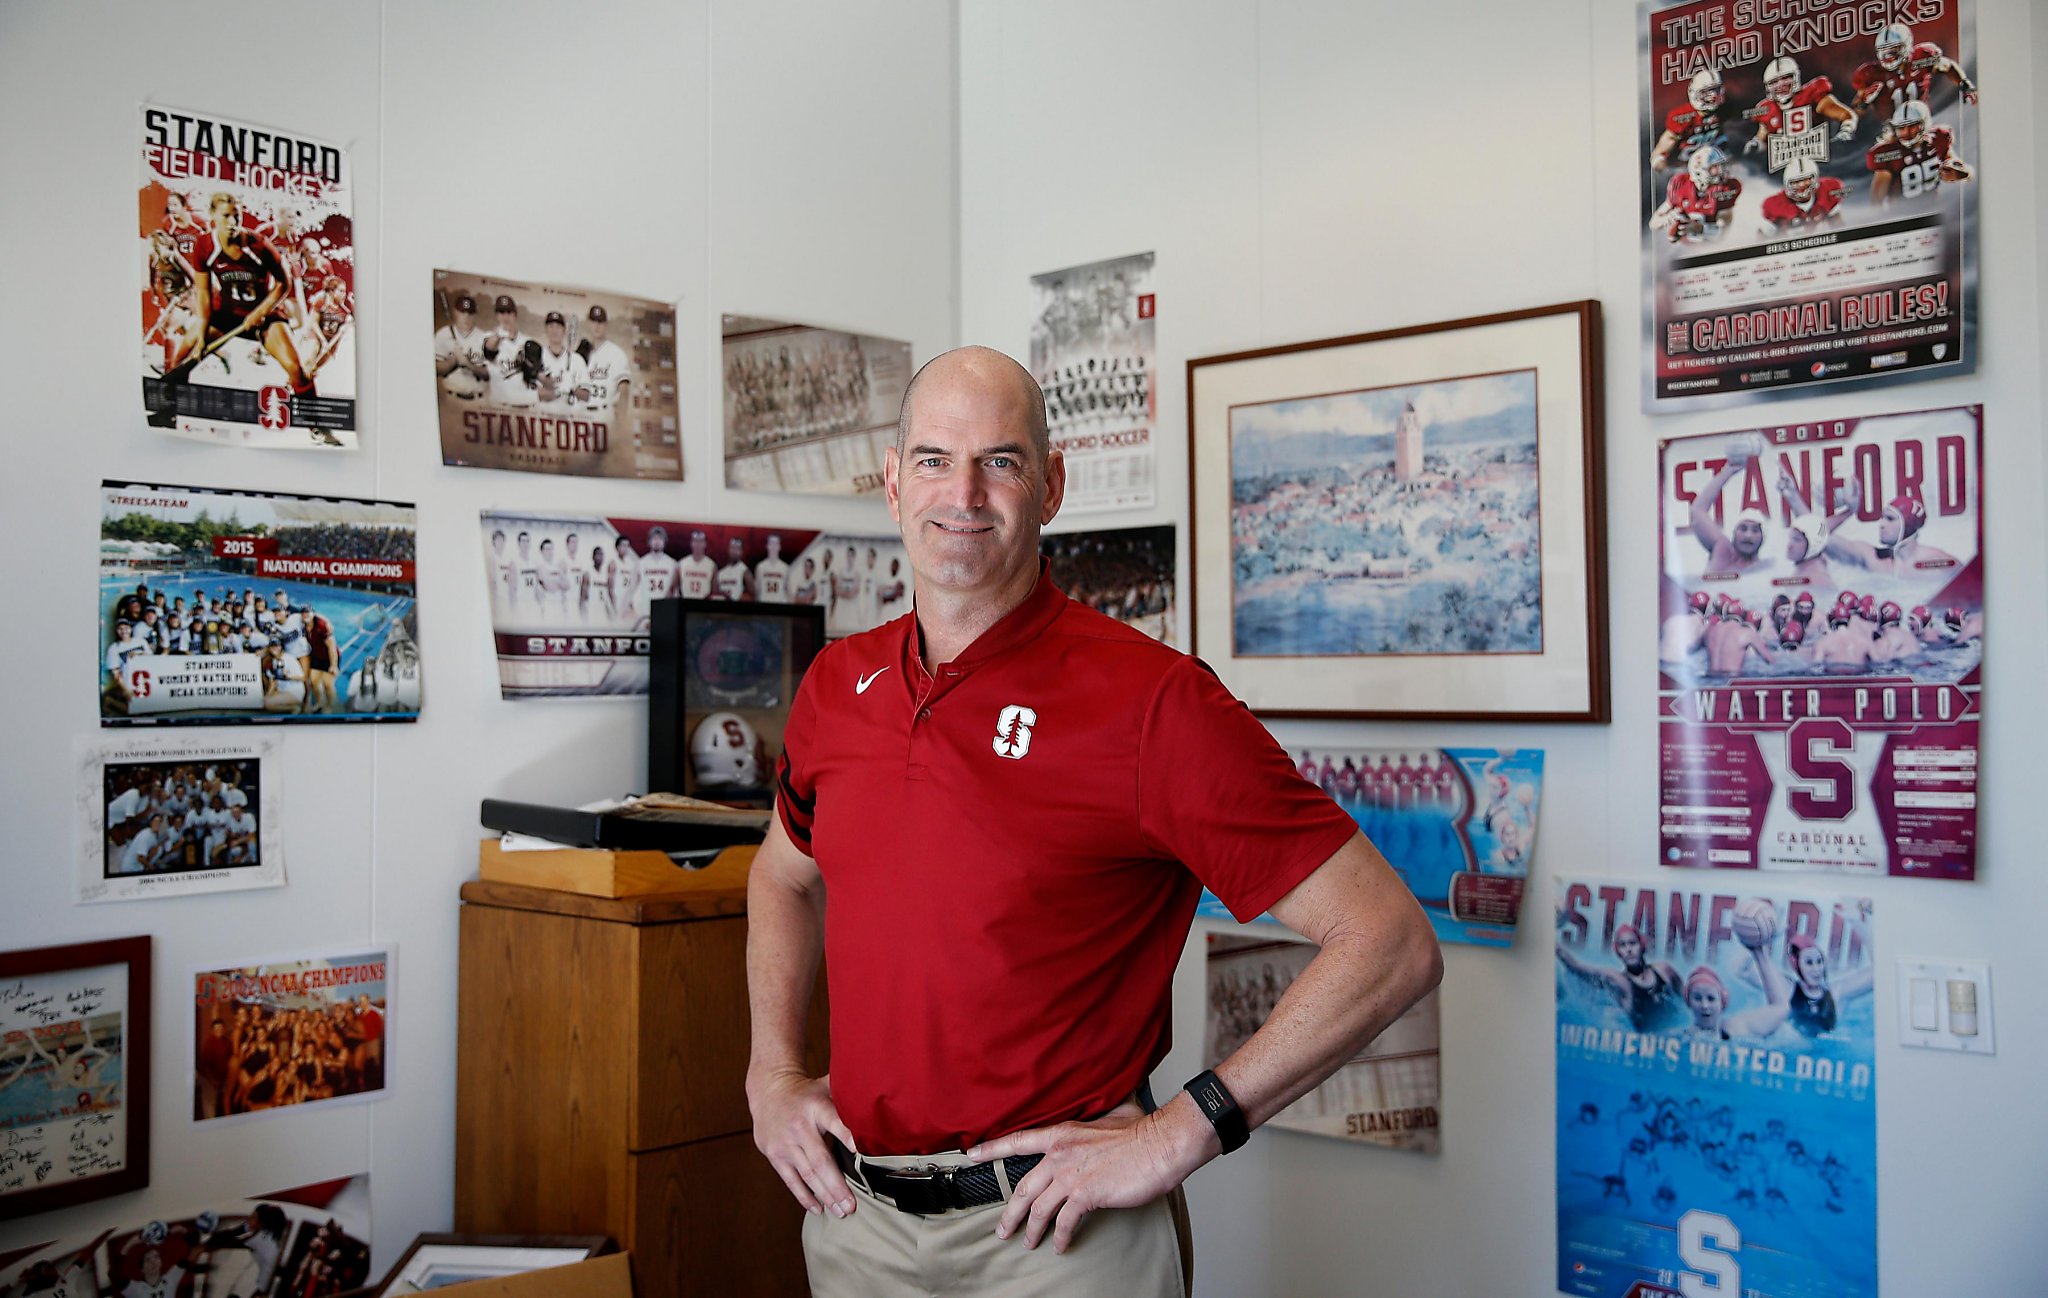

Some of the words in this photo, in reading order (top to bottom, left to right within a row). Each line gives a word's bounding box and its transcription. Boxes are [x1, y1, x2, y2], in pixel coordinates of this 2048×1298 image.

[1661, 5, 1726, 49] THE
[1732, 0, 1855, 30] SCH
[1661, 31, 1764, 85] HARD
[1772, 0, 1945, 57] KNOCKS
[1791, 111, 1805, 133] S
[146, 109, 341, 184] STANFORD
[1774, 146, 1822, 162] FOOTBALL
[1775, 132, 1821, 151] STANFORD
[145, 145, 222, 181] FIELD
[235, 162, 340, 197] HOCKEY
[1901, 158, 1942, 198] 85
[1790, 233, 1839, 251] SCHEDULE
[1667, 321, 1690, 355] THE
[1692, 299, 1838, 352] CARDINAL
[1840, 281, 1949, 332] RULES!
[1667, 359, 1682, 370] GET
[1684, 356, 1715, 368] TICKETS
[1716, 354, 1727, 364] BY
[1728, 351, 1761, 364] CALLING
[1832, 339, 1845, 350] OR
[1845, 336, 1868, 348] VISIT
[1868, 322, 1949, 344] GOSTANFORD.COM
[258, 385, 291, 431] S
[464, 411, 609, 453] STANFORD
[1101, 429, 1149, 447] SOCCER
[1775, 421, 1846, 441] 2010
[1674, 435, 1966, 536] STANFORD
[223, 539, 255, 554] 2015
[263, 560, 328, 576] NATIONAL
[329, 560, 403, 578] CHAMPIONS
[185, 660, 232, 671] STANFORD
[131, 669, 151, 697] S
[203, 672, 232, 683] WATER
[235, 672, 258, 683] POLO
[169, 687, 195, 698] NCAA
[197, 686, 249, 697] CHAMPIONS
[1694, 687, 1821, 721] WATER
[1854, 687, 1951, 721] POLO
[722, 719, 745, 749] S
[992, 704, 1037, 760] S
[1786, 716, 1857, 822] S
[1776, 831, 1867, 846] CARDINAL
[1563, 883, 1874, 968] STANFRD
[258, 973, 298, 995] NCAA
[301, 961, 386, 990] CHAMPIONS
[1561, 1023, 1681, 1062] WOMEN'S
[1689, 1040, 1785, 1074] WATER
[1346, 1105, 1439, 1135] STANFORD
[1677, 1208, 1742, 1298] S
